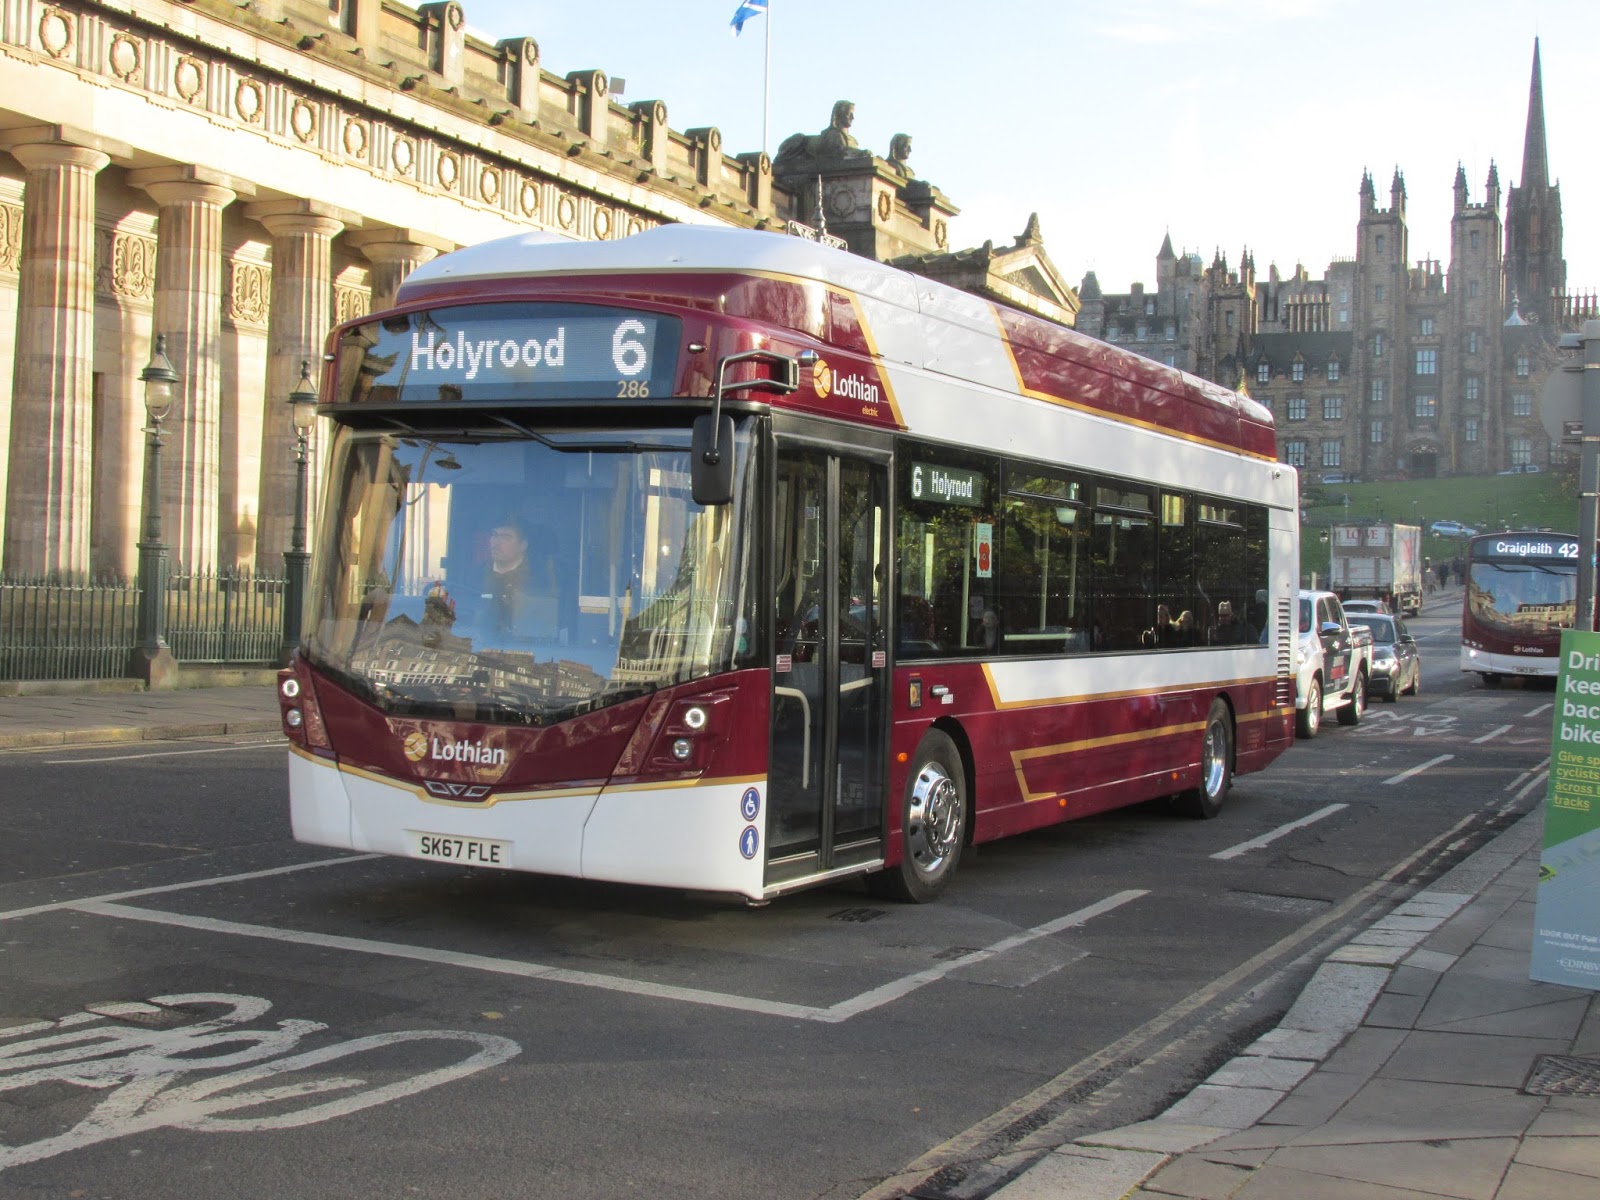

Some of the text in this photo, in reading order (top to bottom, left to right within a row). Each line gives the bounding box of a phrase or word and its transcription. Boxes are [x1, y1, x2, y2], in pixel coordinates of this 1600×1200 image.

[412, 319, 647, 380] Holyrood 6
[616, 380, 650, 398] 286
[833, 369, 879, 403] Lothian
[861, 405, 878, 417] electric
[912, 466, 973, 501] 6 Holyrood
[1496, 541, 1579, 558] Craigleith 42
[1521, 646, 1544, 654] Lothian
[1568, 650, 1600, 671] Dri
[1564, 674, 1600, 696] kee
[1562, 698, 1600, 720] bac
[1560, 722, 1600, 745] bike
[431, 737, 505, 765] Lothian
[1558, 750, 1585, 764] Give
[1556, 767, 1600, 780] cyclists
[1554, 782, 1593, 795] across
[1553, 793, 1591, 809] tracks
[421, 836, 501, 863] SK67 FLE
